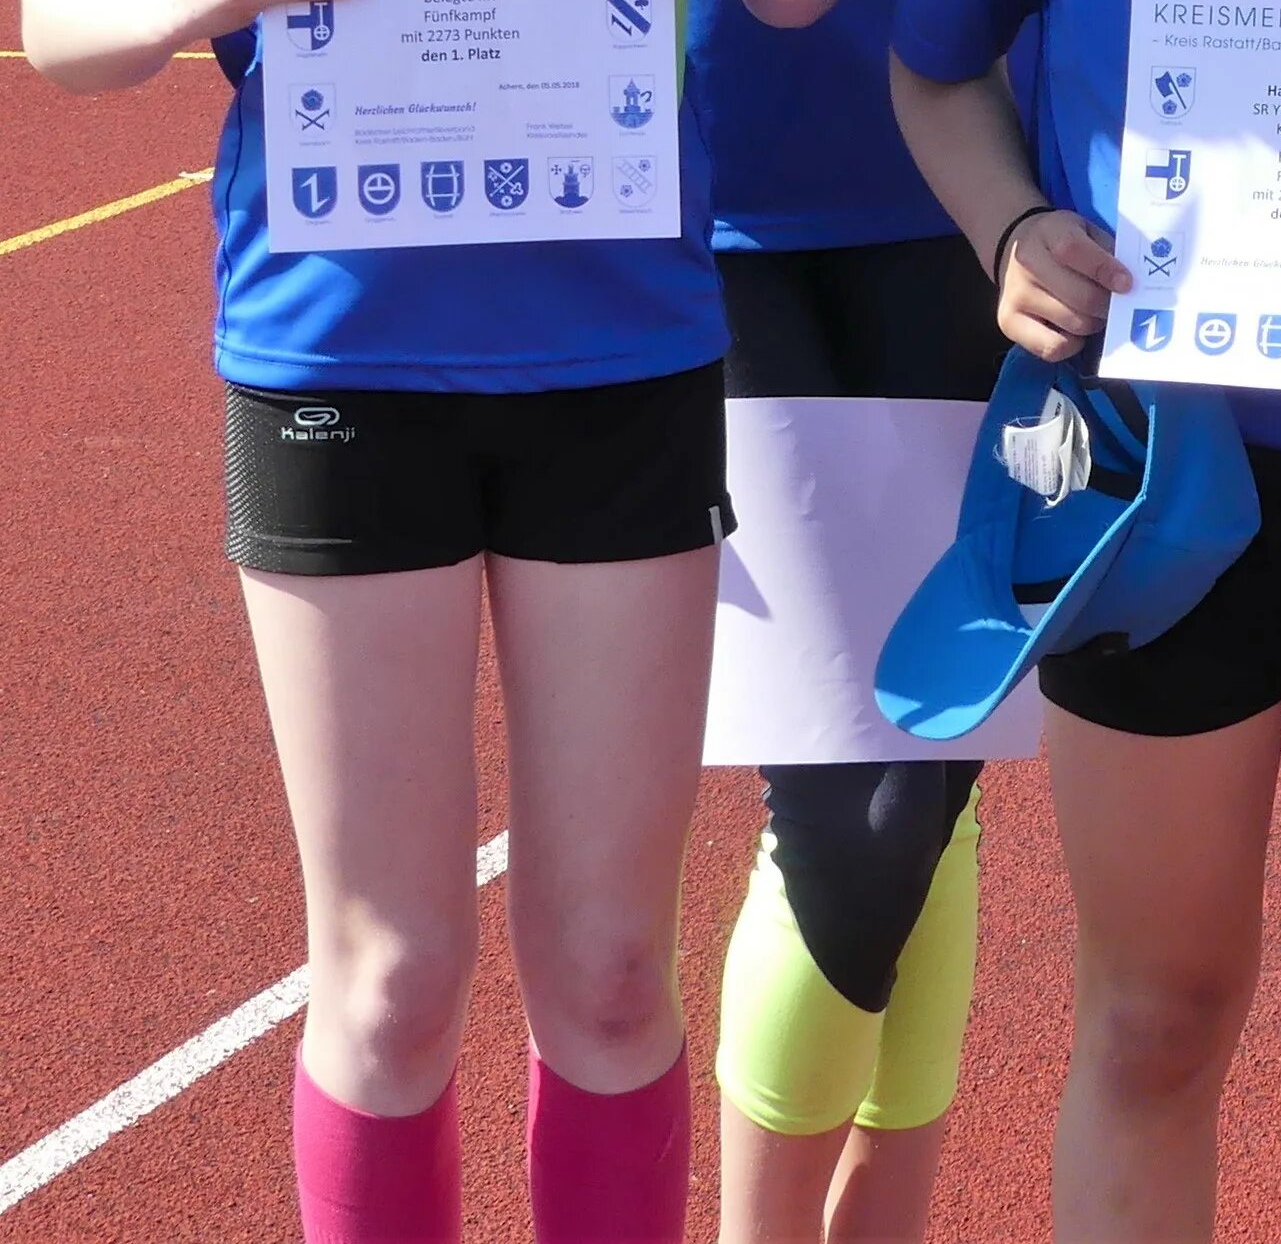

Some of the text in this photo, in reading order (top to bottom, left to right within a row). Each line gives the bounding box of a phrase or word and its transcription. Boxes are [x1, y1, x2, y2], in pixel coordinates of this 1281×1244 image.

[424, 7, 496, 23] Fünfkampf
[401, 27, 520, 43] mit 2273 Punkten
[1165, 34, 1198, 48] Kreis
[421, 47, 501, 62] den 1. Platz
[1253, 103, 1269, 115] SR
[1253, 189, 1273, 200] mit
[281, 427, 356, 443] Kalenji
